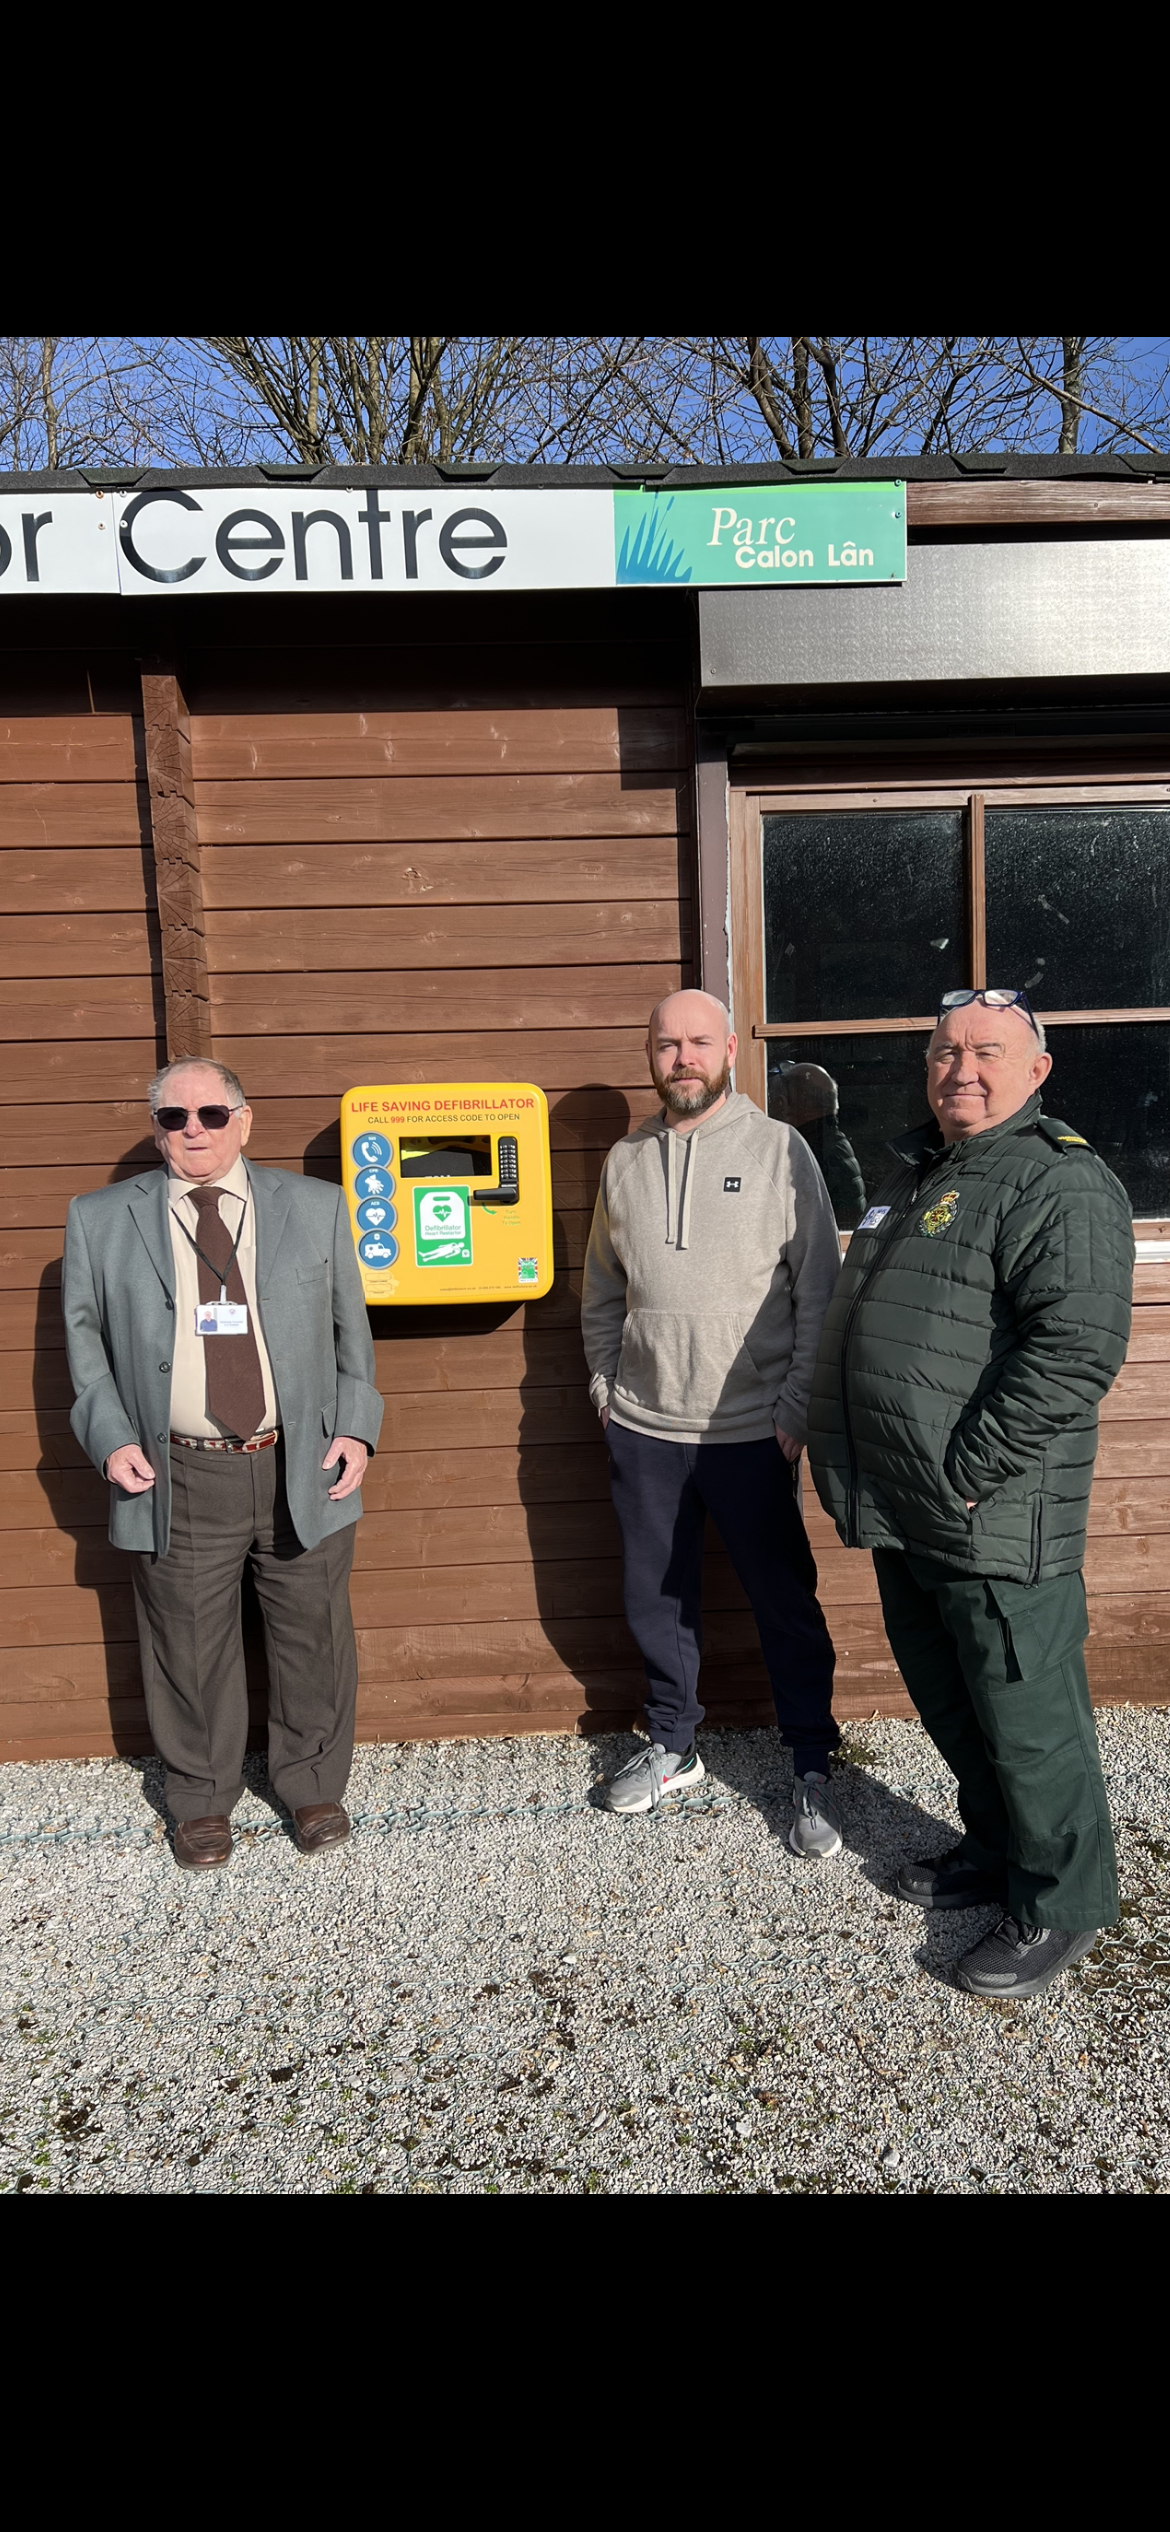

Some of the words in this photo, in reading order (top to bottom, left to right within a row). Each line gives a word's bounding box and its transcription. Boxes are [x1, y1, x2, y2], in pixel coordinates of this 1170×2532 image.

[0, 511, 53, 582] r
[118, 487, 508, 583] Centre
[707, 507, 796, 546] Parc
[735, 545, 814, 569] Calon
[828, 541, 874, 567] Lân
[351, 1102, 379, 1113] LIFE
[382, 1101, 431, 1112] SAVING
[434, 1098, 534, 1110] DEFIBRILLATOR
[367, 1116, 389, 1124] CALL
[390, 1116, 405, 1124] 999
[406, 1115, 424, 1123] FOR
[425, 1114, 459, 1123] ACCESS
[460, 1113, 483, 1122] CODE
[484, 1113, 496, 1121] TO
[497, 1113, 520, 1121] OPEN
